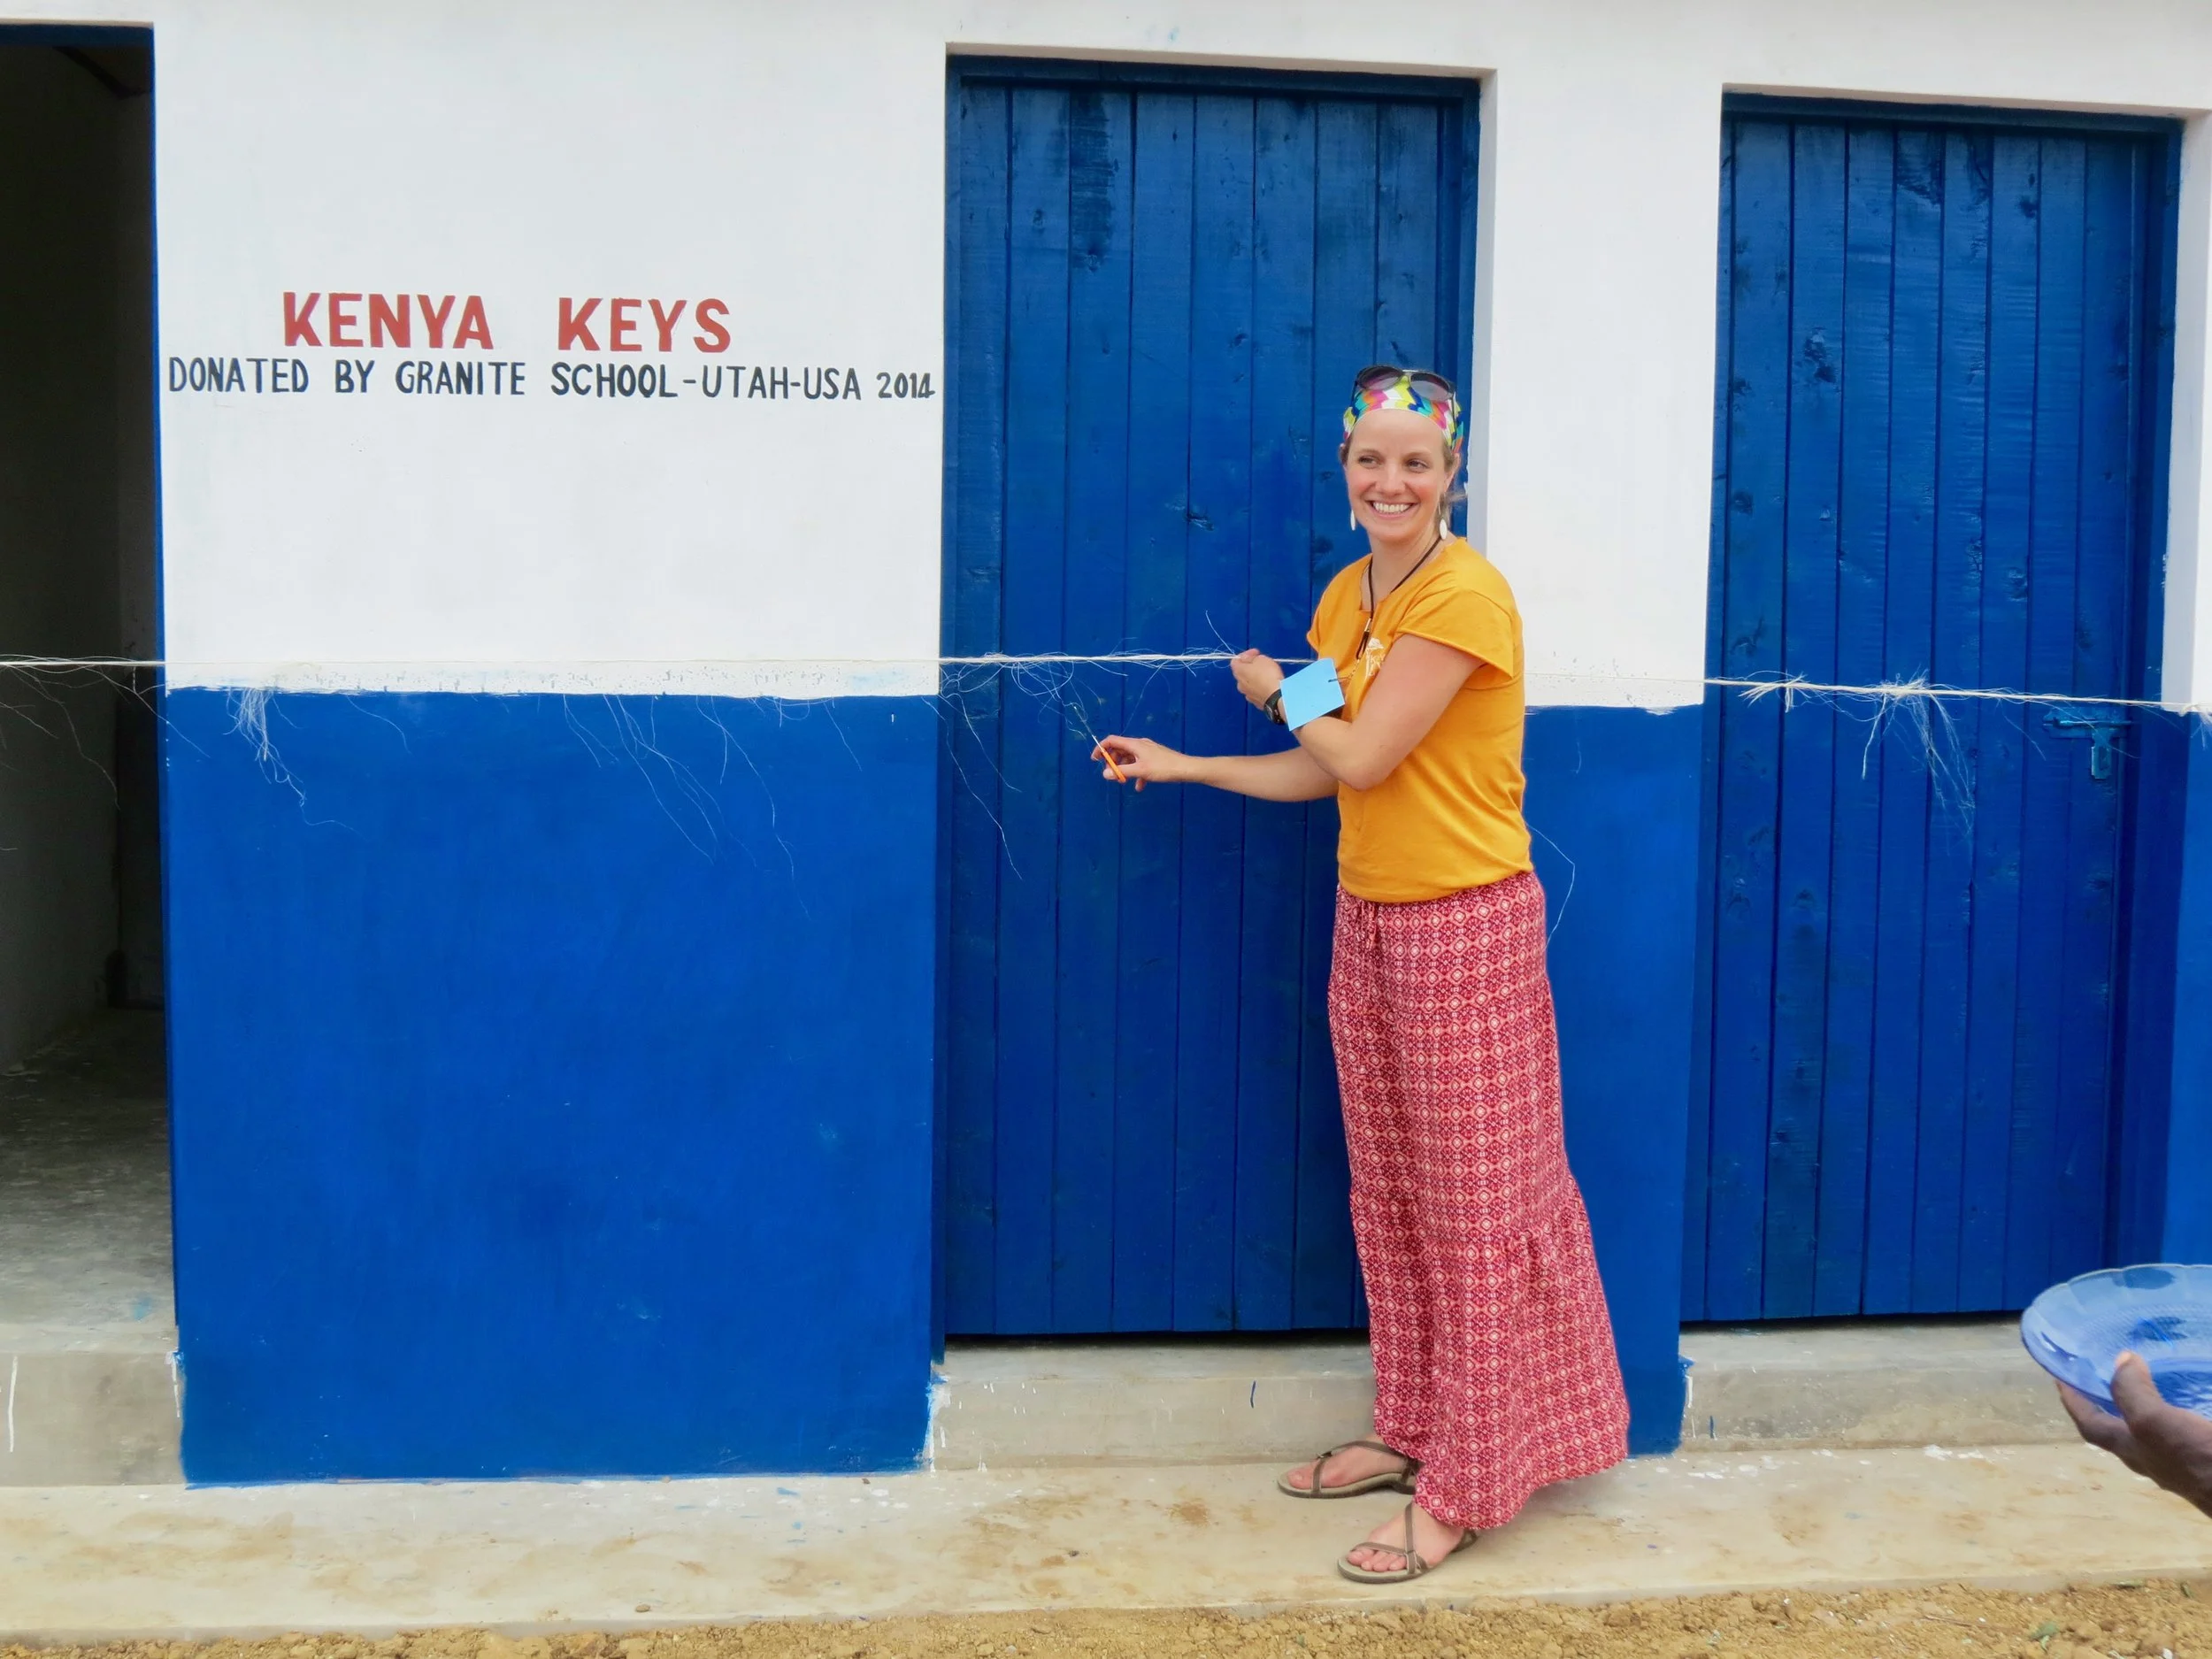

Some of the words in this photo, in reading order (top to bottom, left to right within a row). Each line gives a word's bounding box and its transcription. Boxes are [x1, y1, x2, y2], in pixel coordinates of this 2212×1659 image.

[283, 291, 494, 350] KENYA
[557, 296, 732, 353] KEYS
[168, 357, 309, 394] DONATED
[334, 359, 375, 394] BY
[395, 360, 526, 396] GRANITE
[876, 372, 936, 399] 2014
